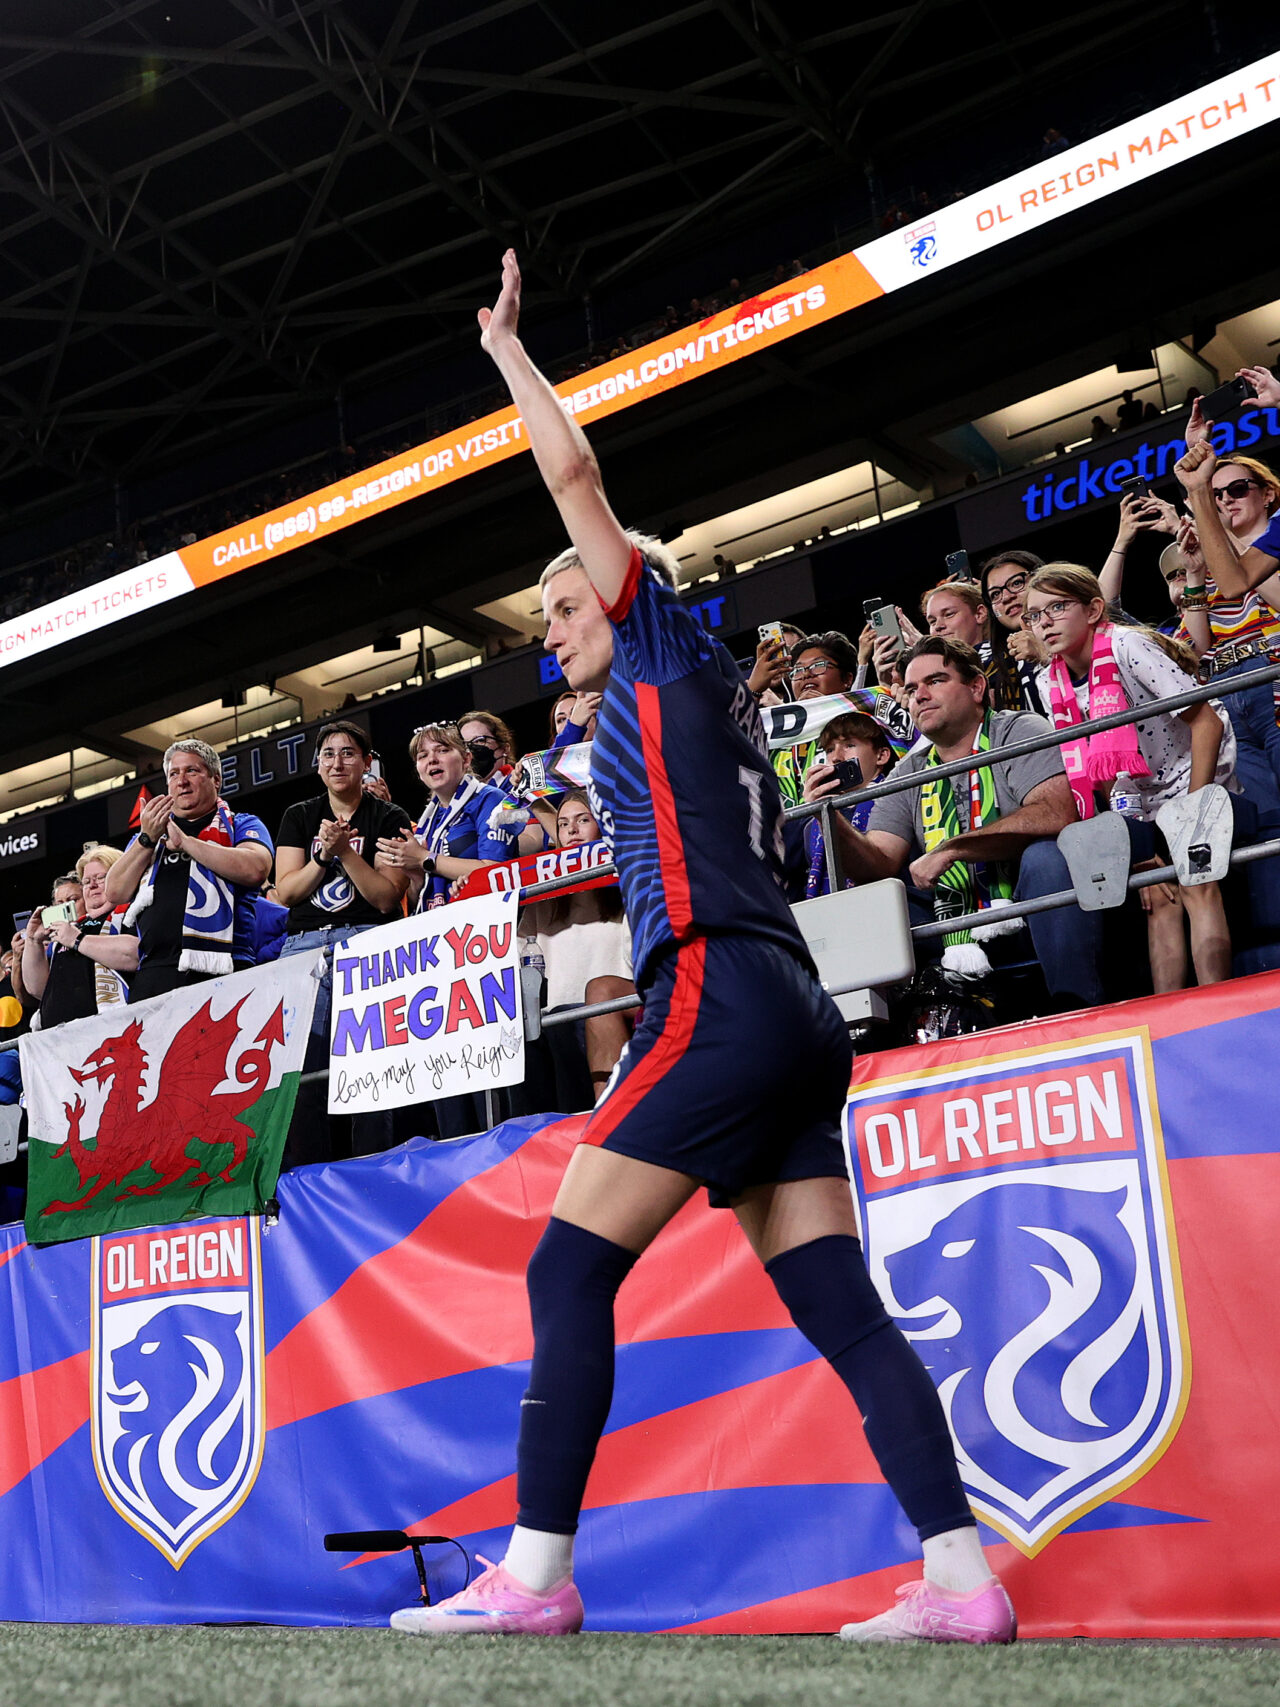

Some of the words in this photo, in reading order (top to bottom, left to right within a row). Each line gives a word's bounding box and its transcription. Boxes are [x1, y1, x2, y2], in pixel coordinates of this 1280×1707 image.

[976, 204, 1013, 233] OL
[1019, 151, 1121, 213] REIGN
[1127, 92, 1248, 163] MATCH
[213, 533, 264, 566] CALL
[264, 506, 318, 550] (866)
[318, 462, 422, 523] 99-REIGN
[422, 449, 454, 478] OR
[455, 418, 523, 462] VISIT
[559, 284, 827, 418] REIGN.COM/TICKETS
[30, 605, 87, 641] MATCH
[91, 572, 168, 615] TICKETS
[486, 828, 515, 846] ally
[336, 934, 441, 996] THANK
[443, 921, 512, 970] YOU
[331, 966, 517, 1057] MEGAN
[424, 1052, 457, 1089] you
[864, 1107, 937, 1180] OL
[943, 1070, 1124, 1163] REIGN
[107, 1243, 145, 1293] OL
[149, 1227, 243, 1285] REIGN
